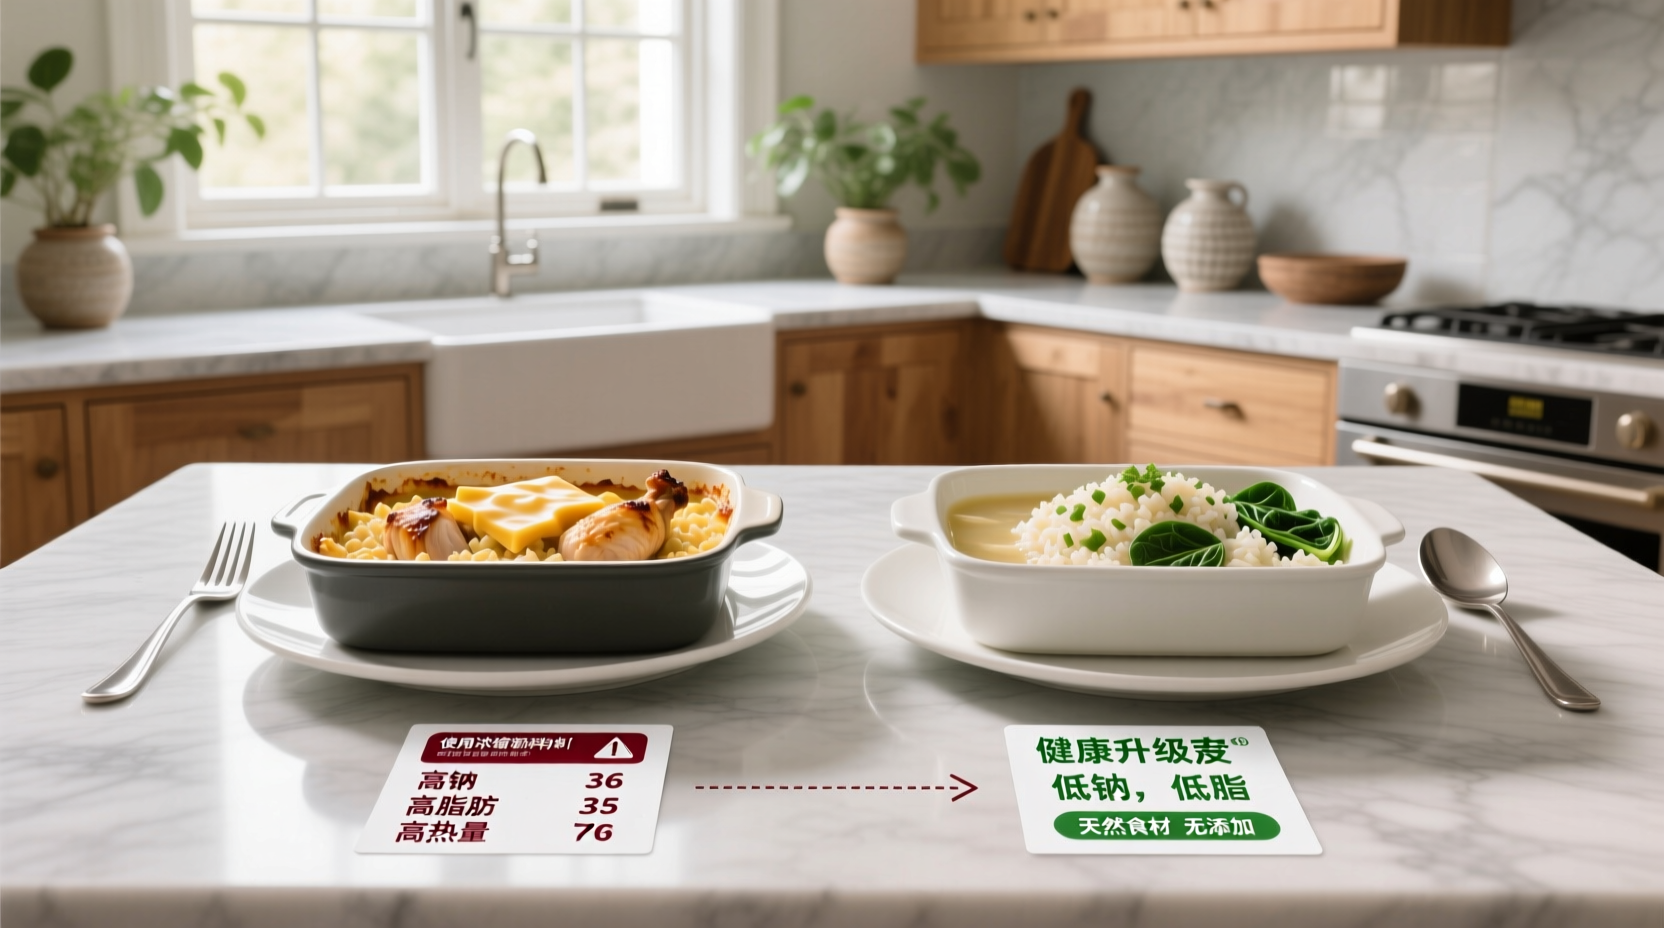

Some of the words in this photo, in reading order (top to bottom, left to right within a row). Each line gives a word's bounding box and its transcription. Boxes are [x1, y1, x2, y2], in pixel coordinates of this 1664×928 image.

[418, 771, 478, 790] 高钠
[585, 772, 623, 789] 36
[406, 795, 499, 816] 高脂肪
[579, 797, 619, 815] 35
[395, 821, 489, 843] 高热量
[573, 822, 613, 842] 76
[1078, 816, 1171, 836] 天然食材
[1183, 816, 1256, 836] 无添加
